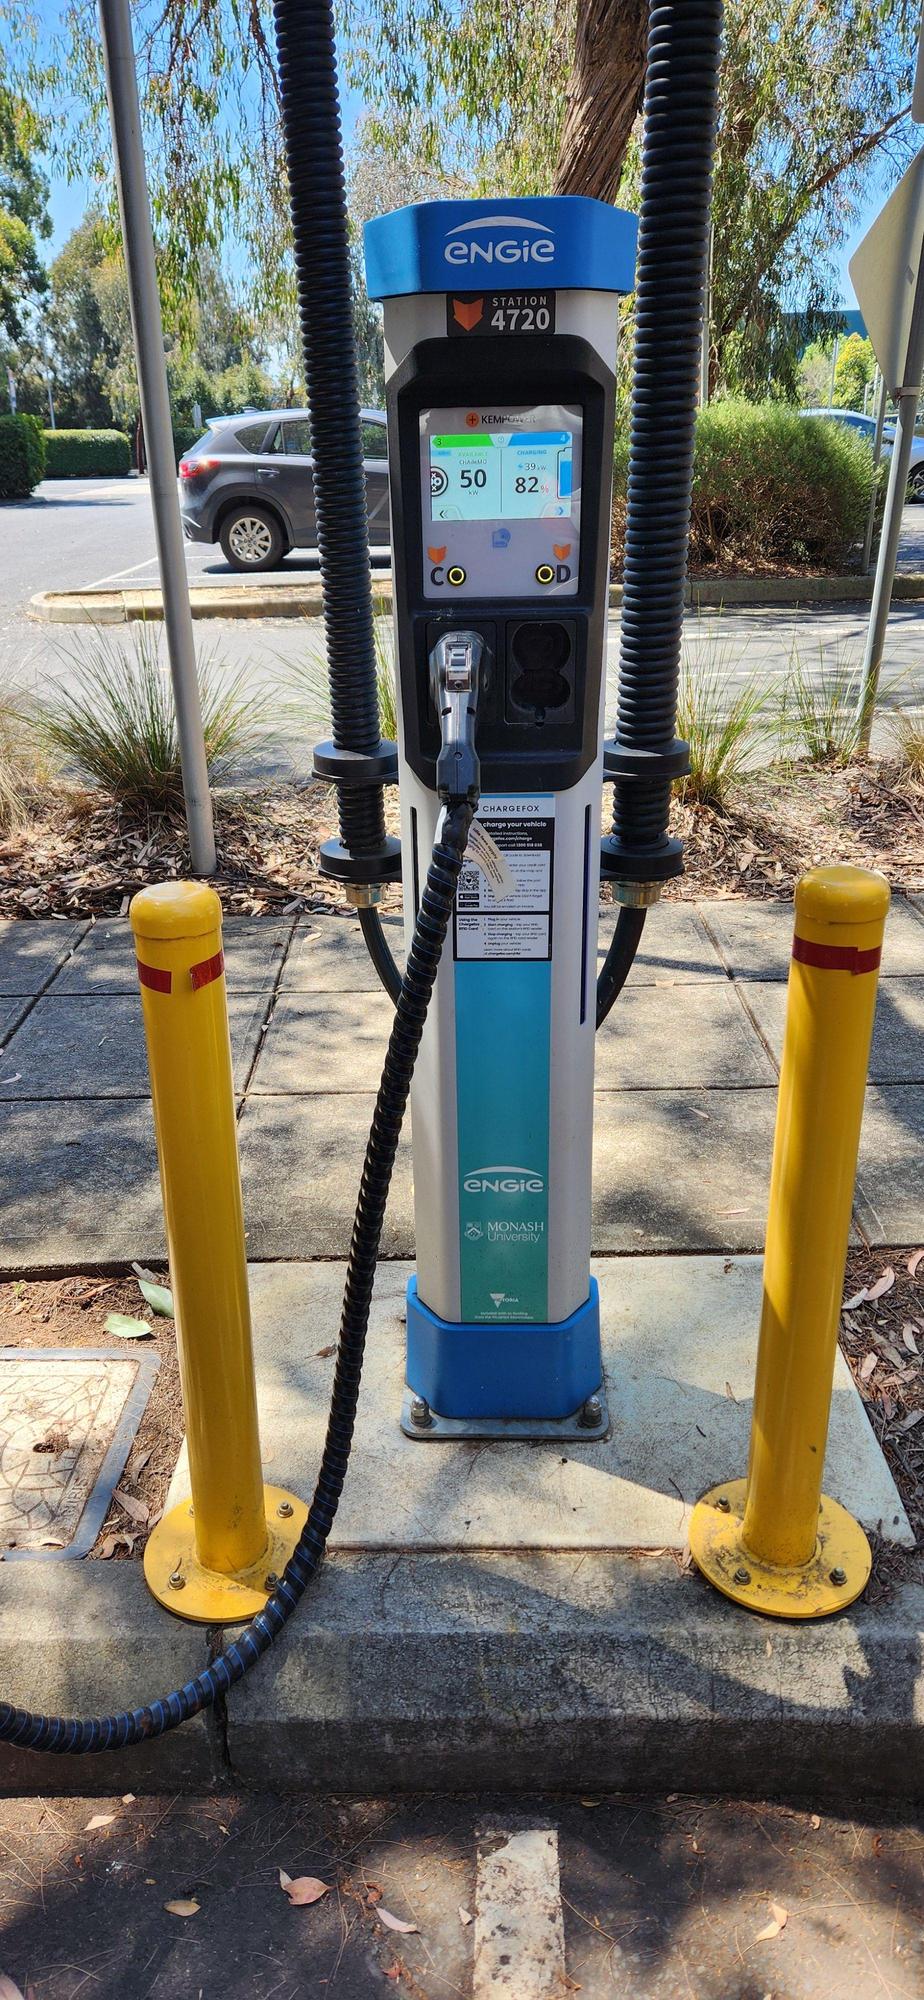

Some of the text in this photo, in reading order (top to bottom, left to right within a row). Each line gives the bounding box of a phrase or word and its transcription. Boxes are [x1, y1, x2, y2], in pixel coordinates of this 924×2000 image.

[492, 296, 547, 307] STATION
[490, 308, 550, 331] 4720
[437, 438, 442, 446] 3
[560, 434, 566, 442] 4
[460, 469, 487, 488] 50
[515, 476, 539, 494] 82
[430, 566, 444, 586] C
[556, 564, 571, 583] D
[483, 821, 506, 829] charge
[487, 1221, 544, 1232] MONASH
[487, 1231, 540, 1243] University
